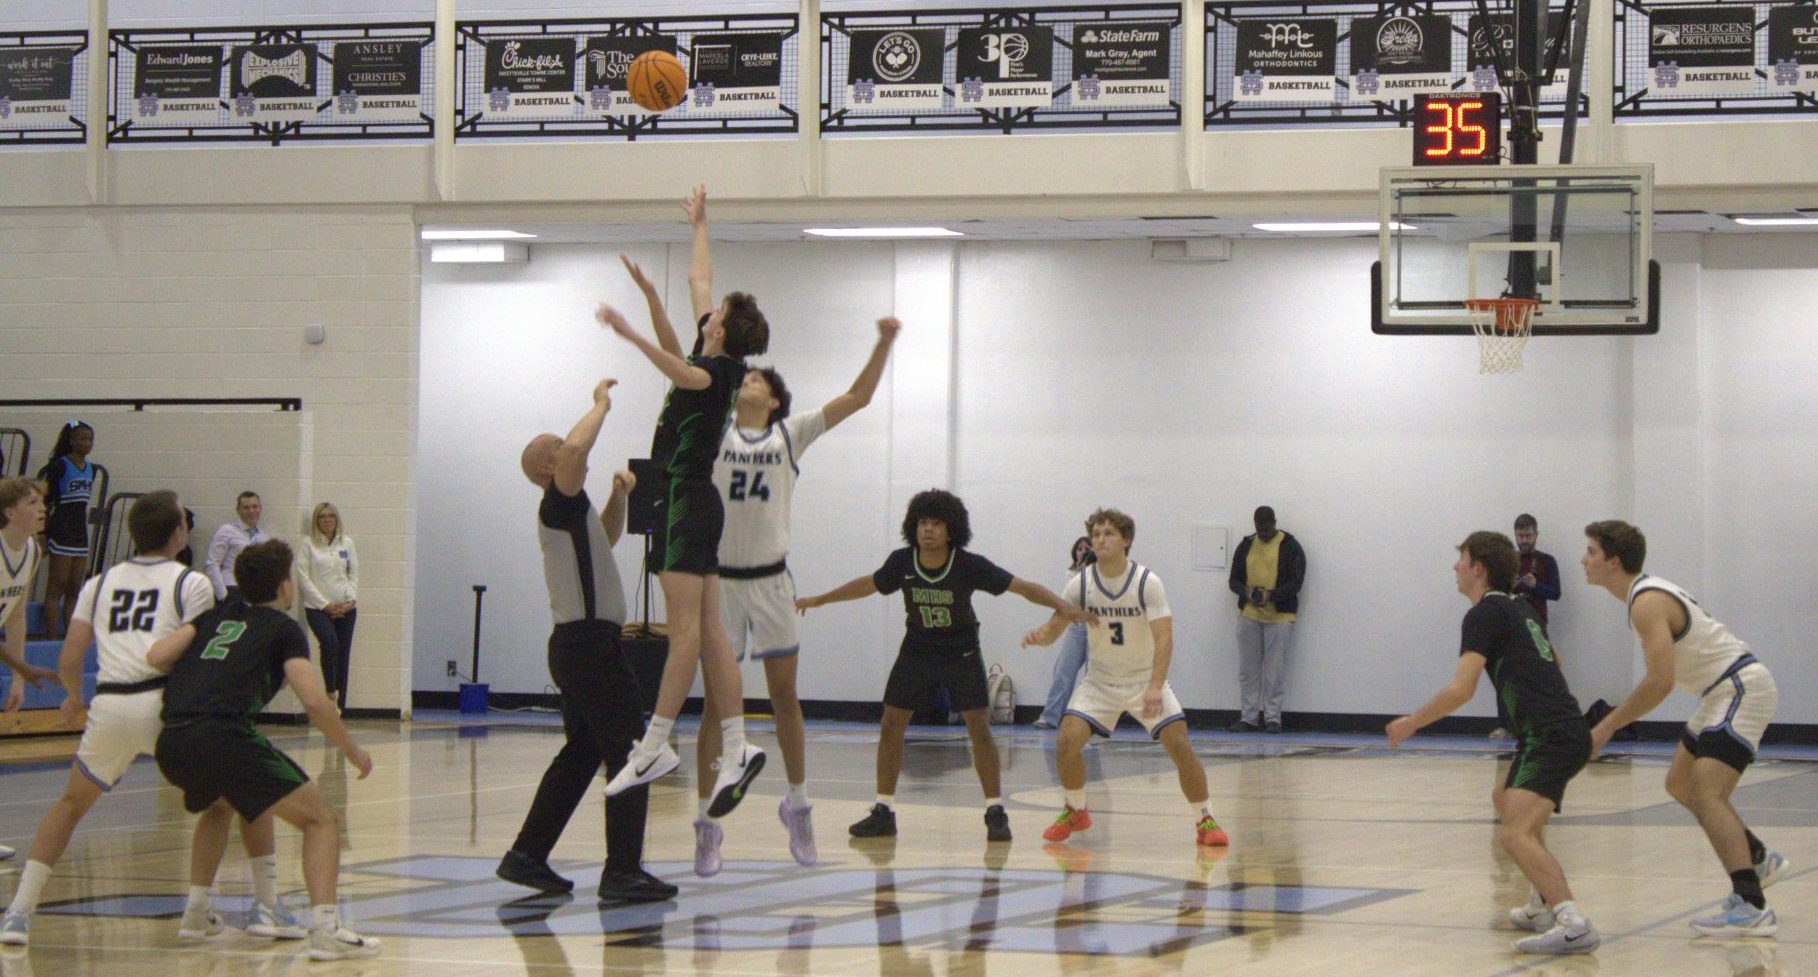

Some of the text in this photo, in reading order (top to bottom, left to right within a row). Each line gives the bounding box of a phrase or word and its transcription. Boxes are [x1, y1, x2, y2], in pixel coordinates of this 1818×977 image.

[1681, 23, 1752, 34] RESURGENS
[1681, 34, 1752, 45] ORTHOPAEDICS
[353, 44, 402, 54] ANSLEY
[902, 39, 915, 54] GO
[502, 48, 564, 70] Chick-fil-A
[607, 50, 634, 63] The
[1085, 49, 1157, 59] Mark Gray, Agent
[1249, 49, 1323, 60] Mahaffey Linkous
[249, 53, 299, 67] EXPLOSIVE
[249, 68, 299, 84] MECHANICS
[1685, 72, 1751, 82] BASKETBALL
[1268, 81, 1331, 90] BASKETBALL
[1385, 78, 1448, 88] BASKETBALL
[880, 89, 939, 97] BASKETBALL
[988, 87, 1048, 96] BASKETBALL
[1105, 85, 1166, 94] BASKETBALL
[514, 97, 570, 106] BASKETBALL
[719, 92, 777, 101] BASKETBALL
[15, 105, 66, 113] BASKETBALL
[163, 103, 216, 111] BASKETBALL
[260, 102, 313, 111] BASKETBALL
[362, 100, 416, 109] BASKETBALL
[1426, 102, 1487, 156] 35
[729, 469, 770, 501] 24
[912, 588, 954, 604] MHS
[109, 588, 160, 633] 22
[1088, 606, 1141, 617] PANTHERS
[920, 605, 952, 628] 13
[1108, 622, 1124, 645] 3
[200, 620, 247, 660] 2
